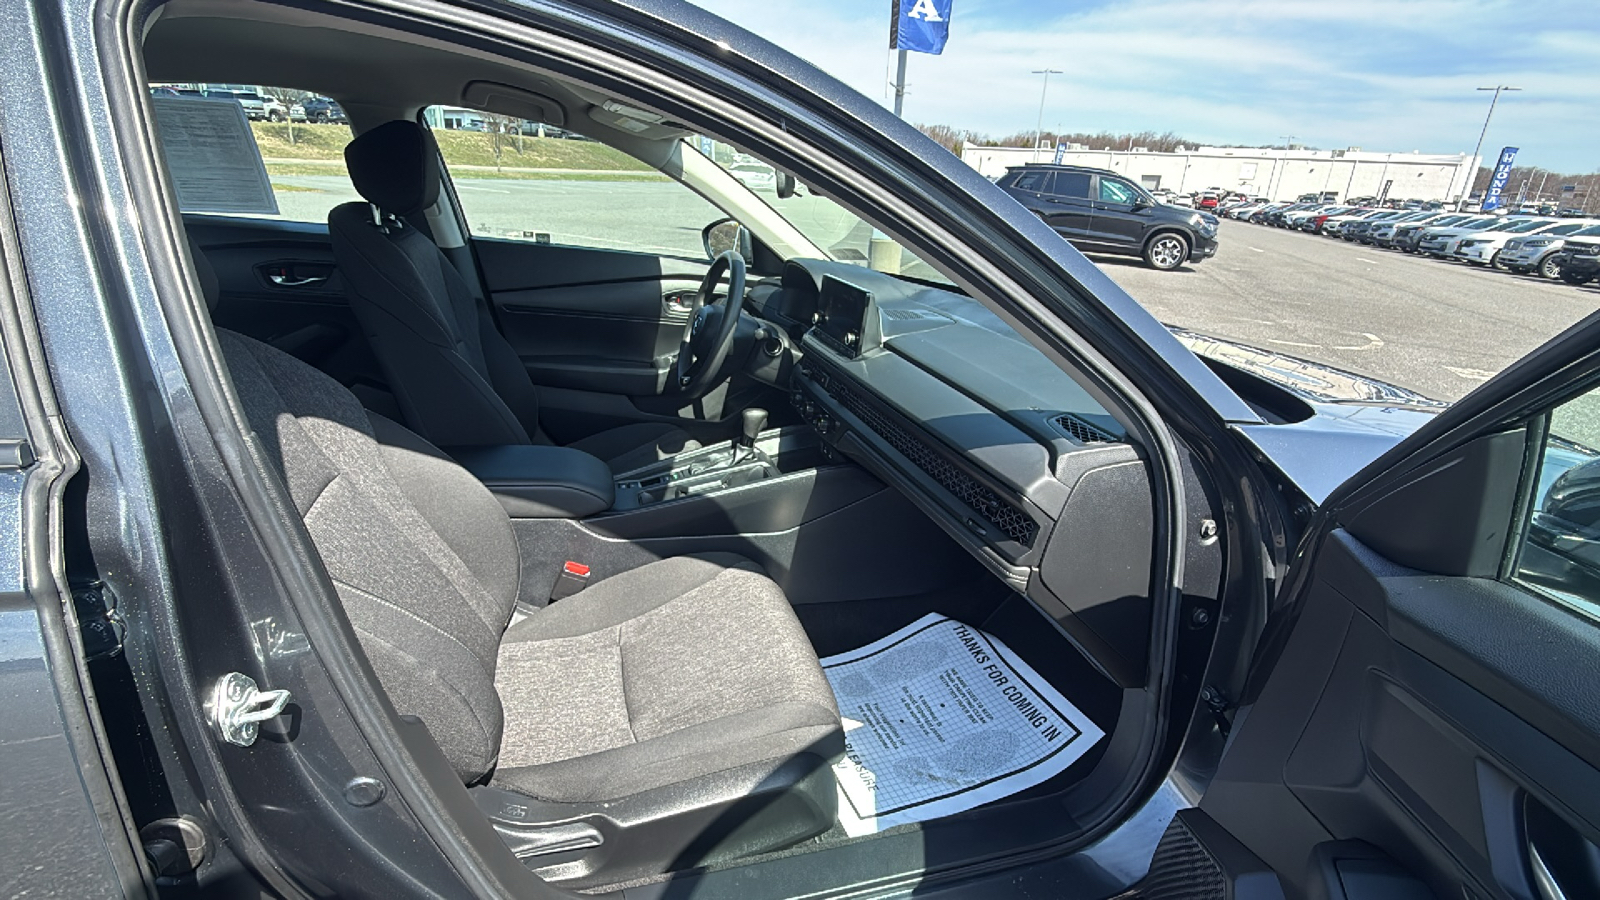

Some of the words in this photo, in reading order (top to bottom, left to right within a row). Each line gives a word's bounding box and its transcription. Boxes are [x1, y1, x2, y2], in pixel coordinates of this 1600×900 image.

[908, 0, 944, 22] A
[1487, 164, 1511, 204] HONDA
[953, 624, 990, 664] THANKS
[983, 664, 1009, 687] FOR
[1002, 686, 1047, 729] COMING
[1041, 724, 1062, 742] IN
[973, 708, 987, 724] CLEAN
[846, 742, 880, 792] PLEASURE
